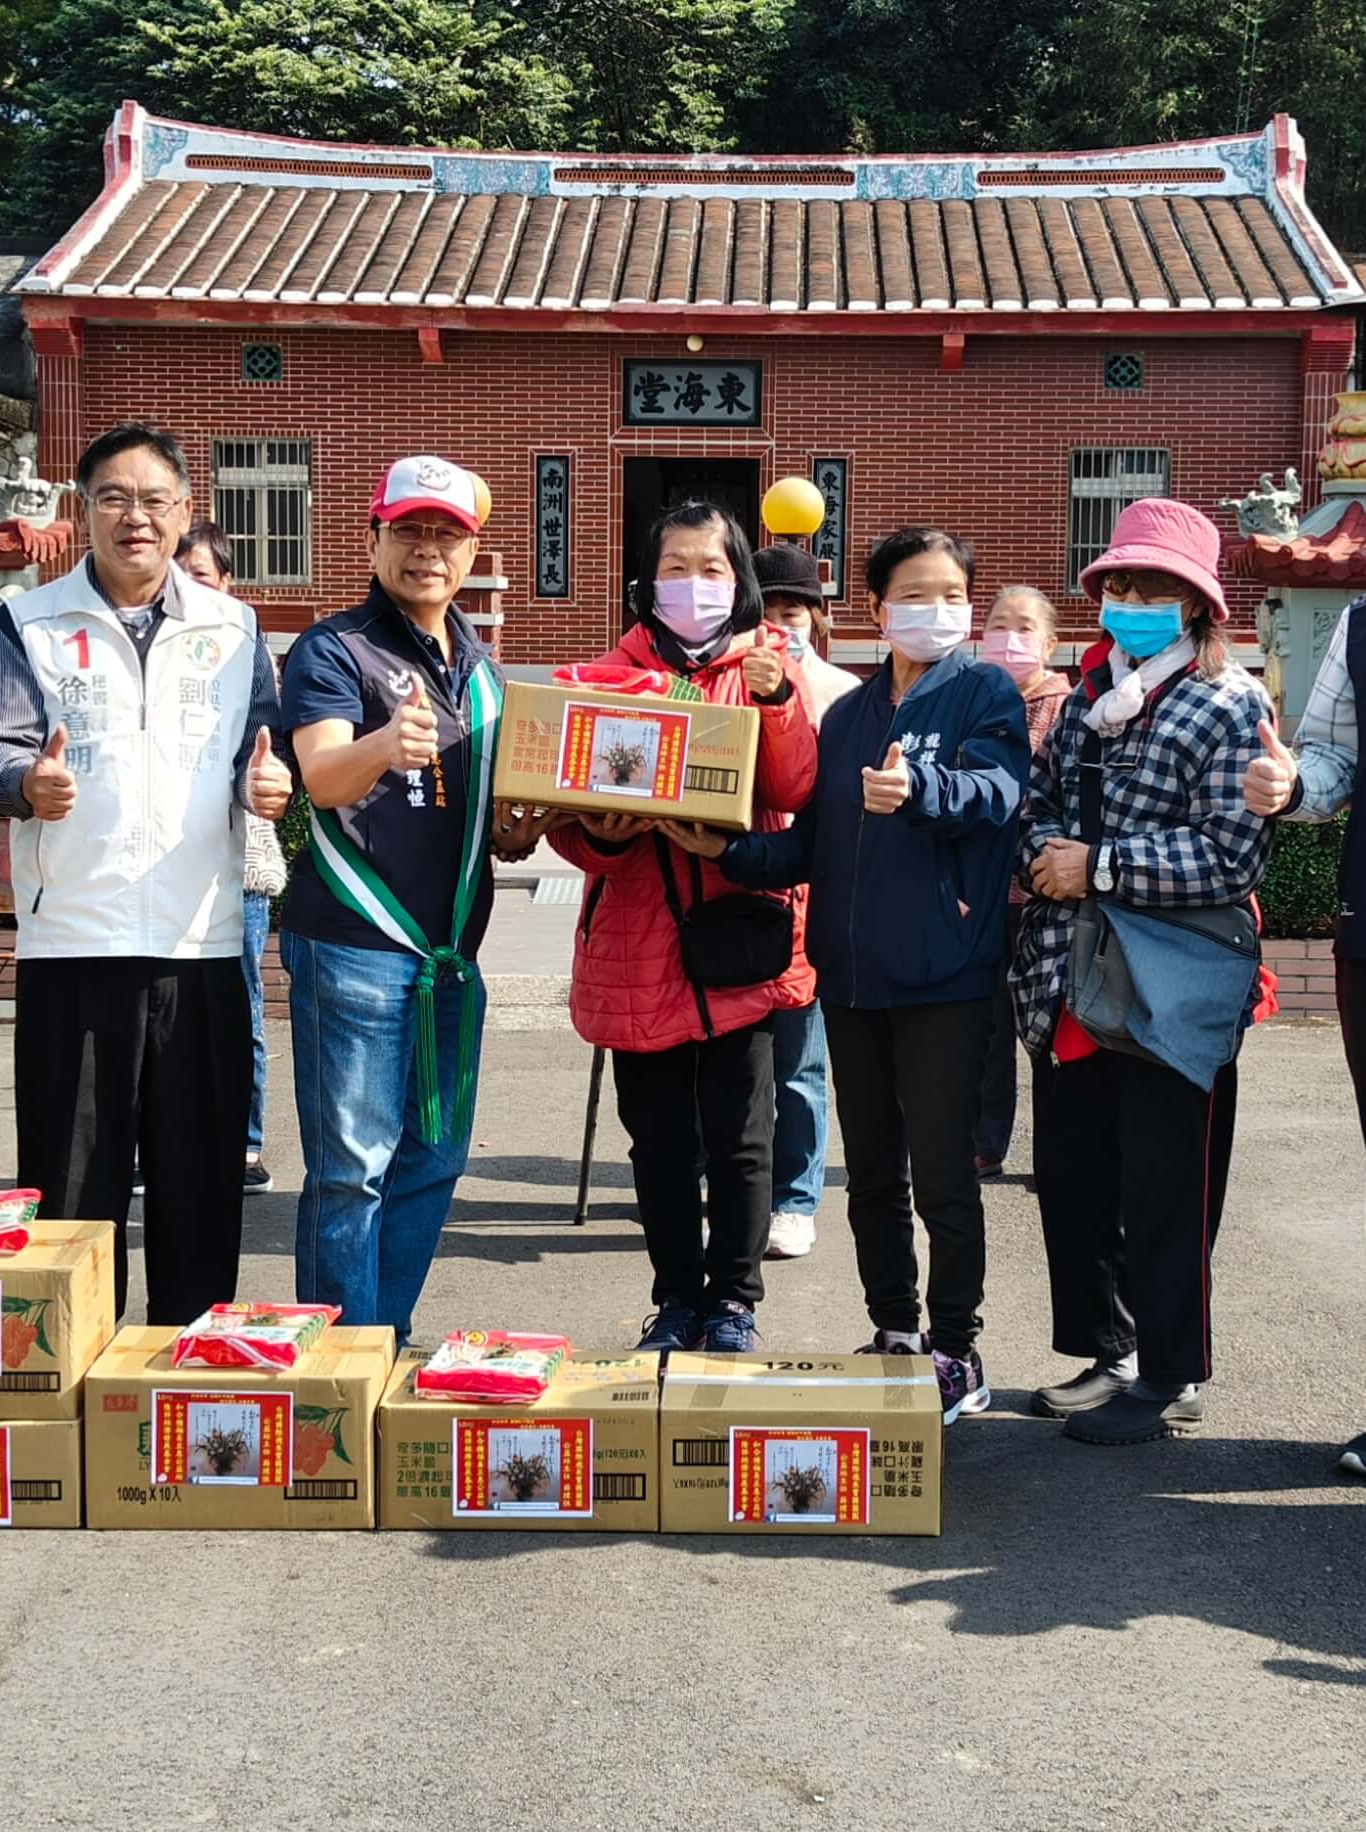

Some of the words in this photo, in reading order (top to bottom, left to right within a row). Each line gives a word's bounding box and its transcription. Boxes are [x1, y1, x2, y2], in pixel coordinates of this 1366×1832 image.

[634, 371, 752, 415] 東海堂
[542, 468, 563, 587] 南洲世澤長
[62, 627, 90, 669] 1
